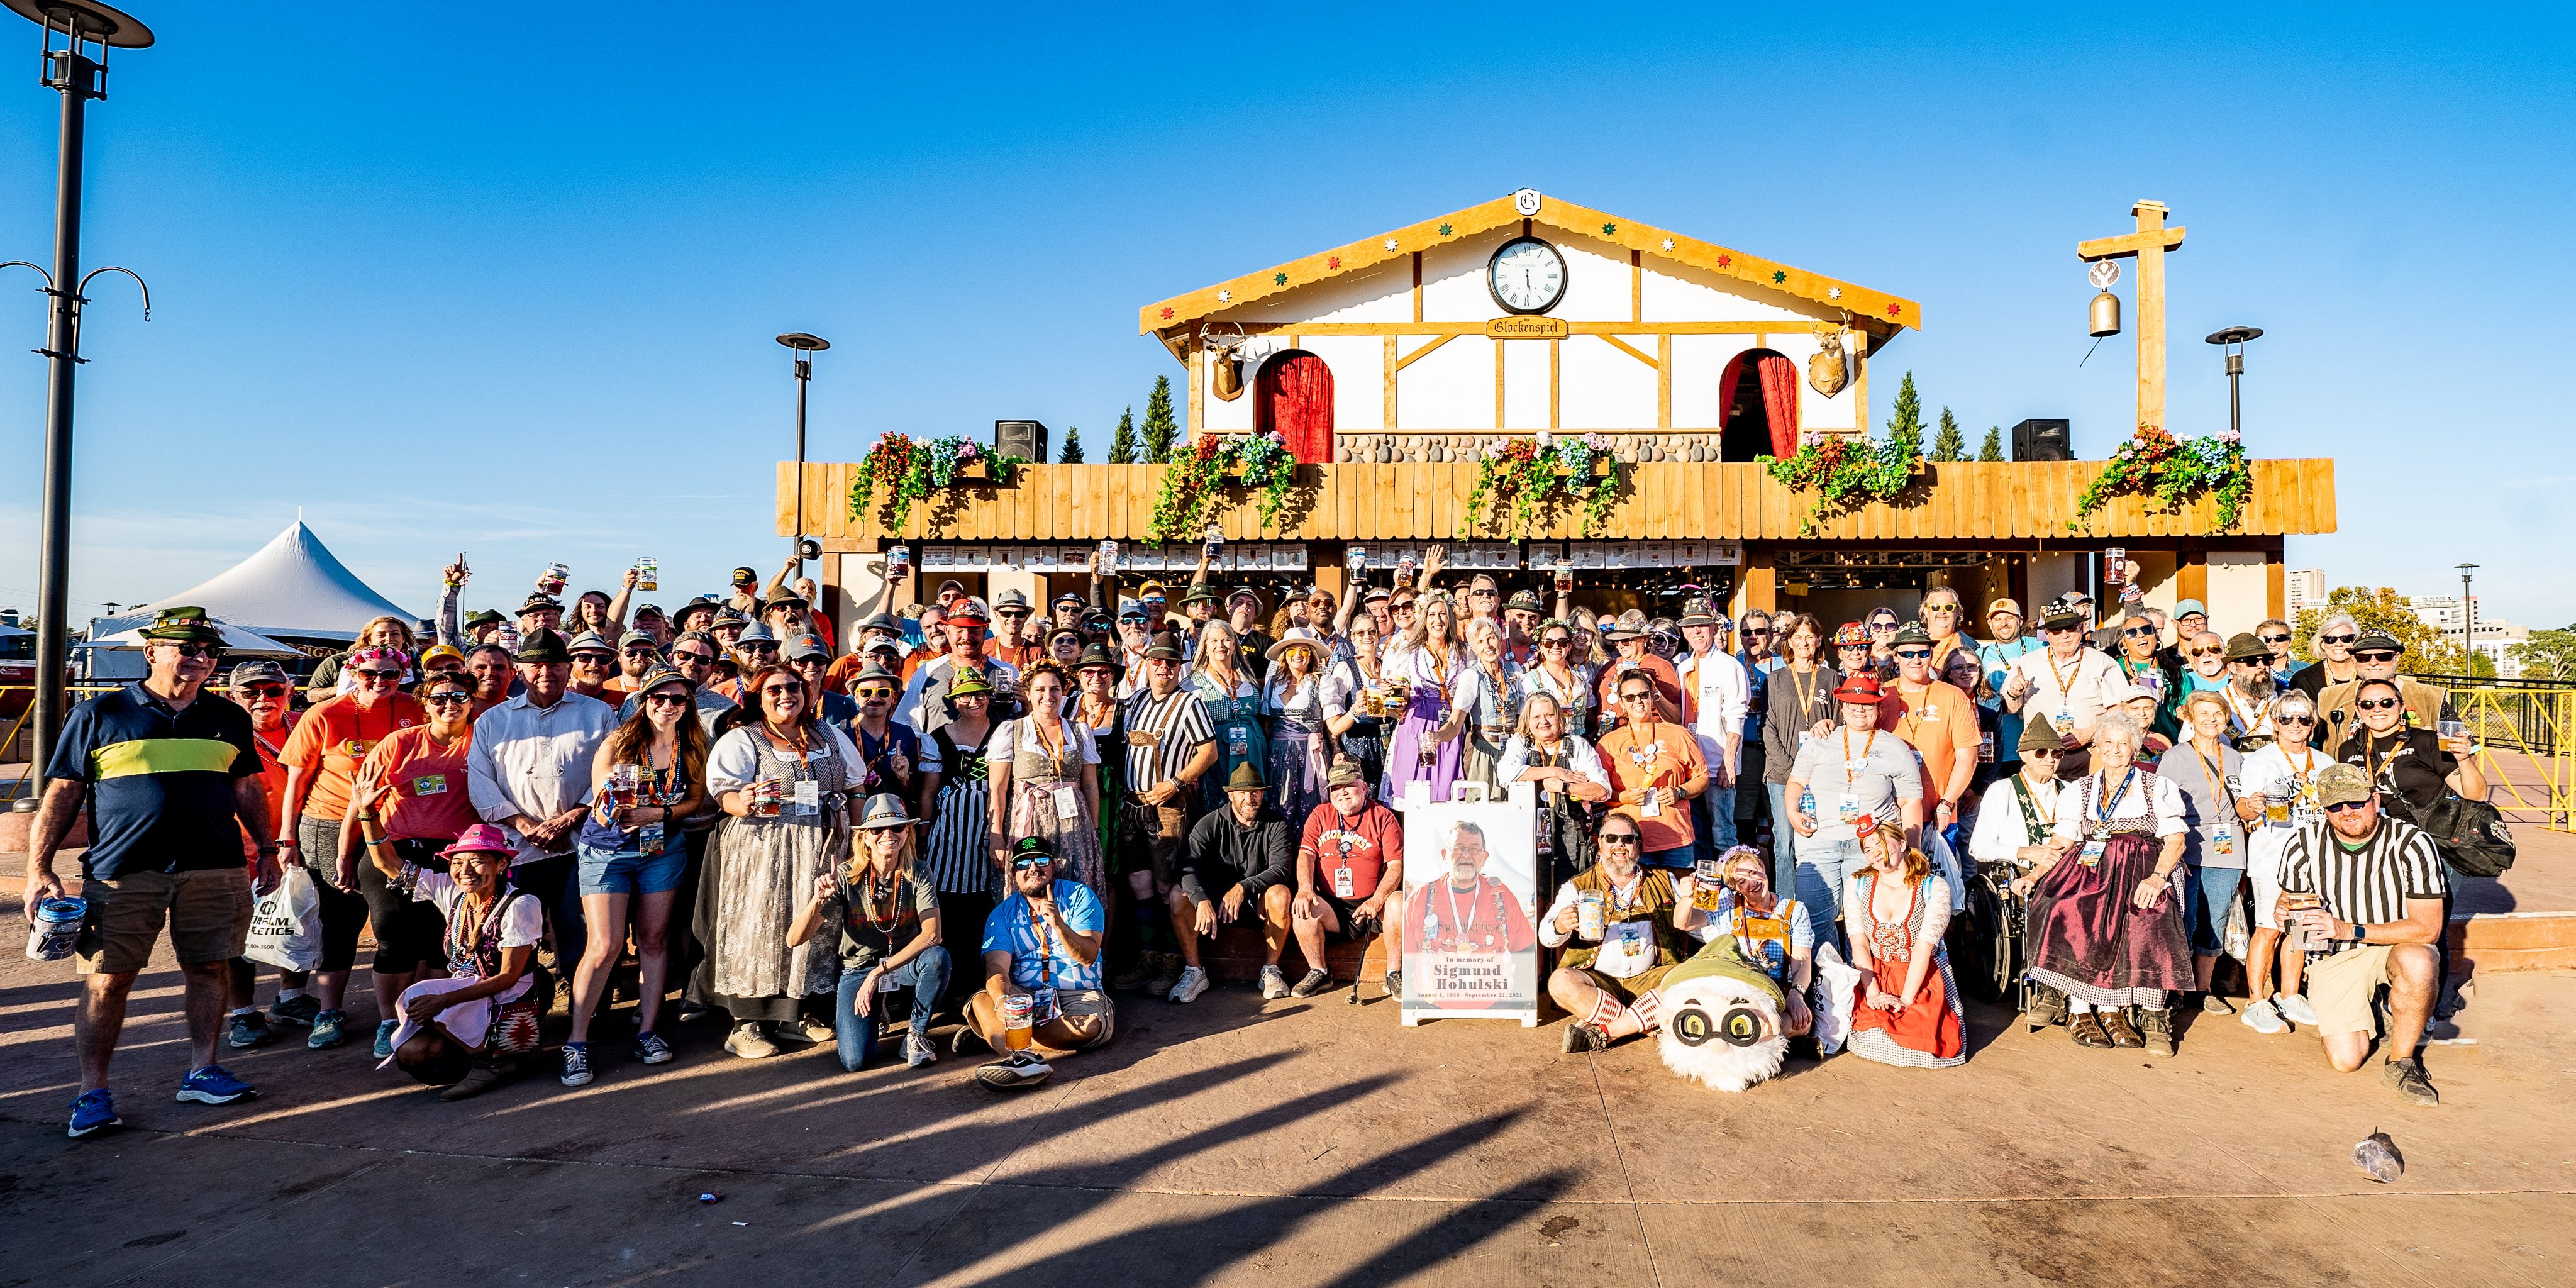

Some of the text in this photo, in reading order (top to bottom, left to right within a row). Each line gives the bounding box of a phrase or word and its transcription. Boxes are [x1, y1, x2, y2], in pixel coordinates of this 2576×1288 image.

[1494, 321, 1558, 336] Glockenspiel
[1318, 829, 1372, 852] OKTOBFEST
[1434, 964, 1501, 979] Sigmund
[1436, 979, 1509, 990] Hohulski
